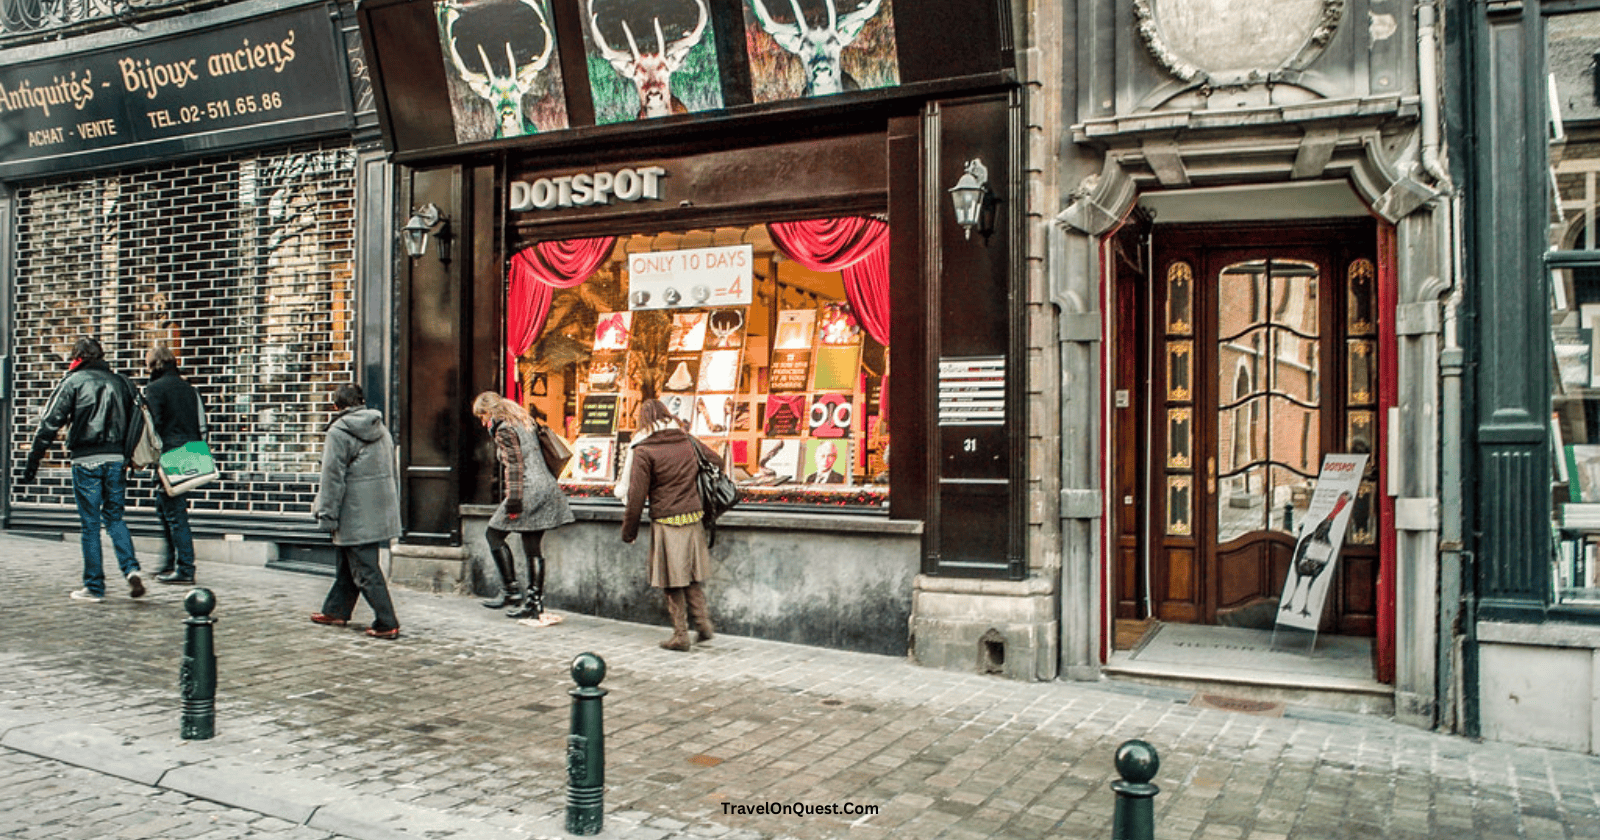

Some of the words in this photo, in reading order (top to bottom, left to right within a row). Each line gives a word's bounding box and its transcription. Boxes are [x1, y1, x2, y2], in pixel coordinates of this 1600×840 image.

[0, 69, 94, 117] Antiquités
[118, 57, 198, 99] Bijoux
[207, 29, 296, 76] anciens
[28, 127, 64, 148] ACHAT
[76, 119, 118, 139] VENTE
[510, 166, 665, 211] DOTSPOT
[632, 256, 674, 274] ONLY
[681, 253, 700, 271] 10
[705, 250, 746, 269] DAYS
[964, 438, 976, 452] 31
